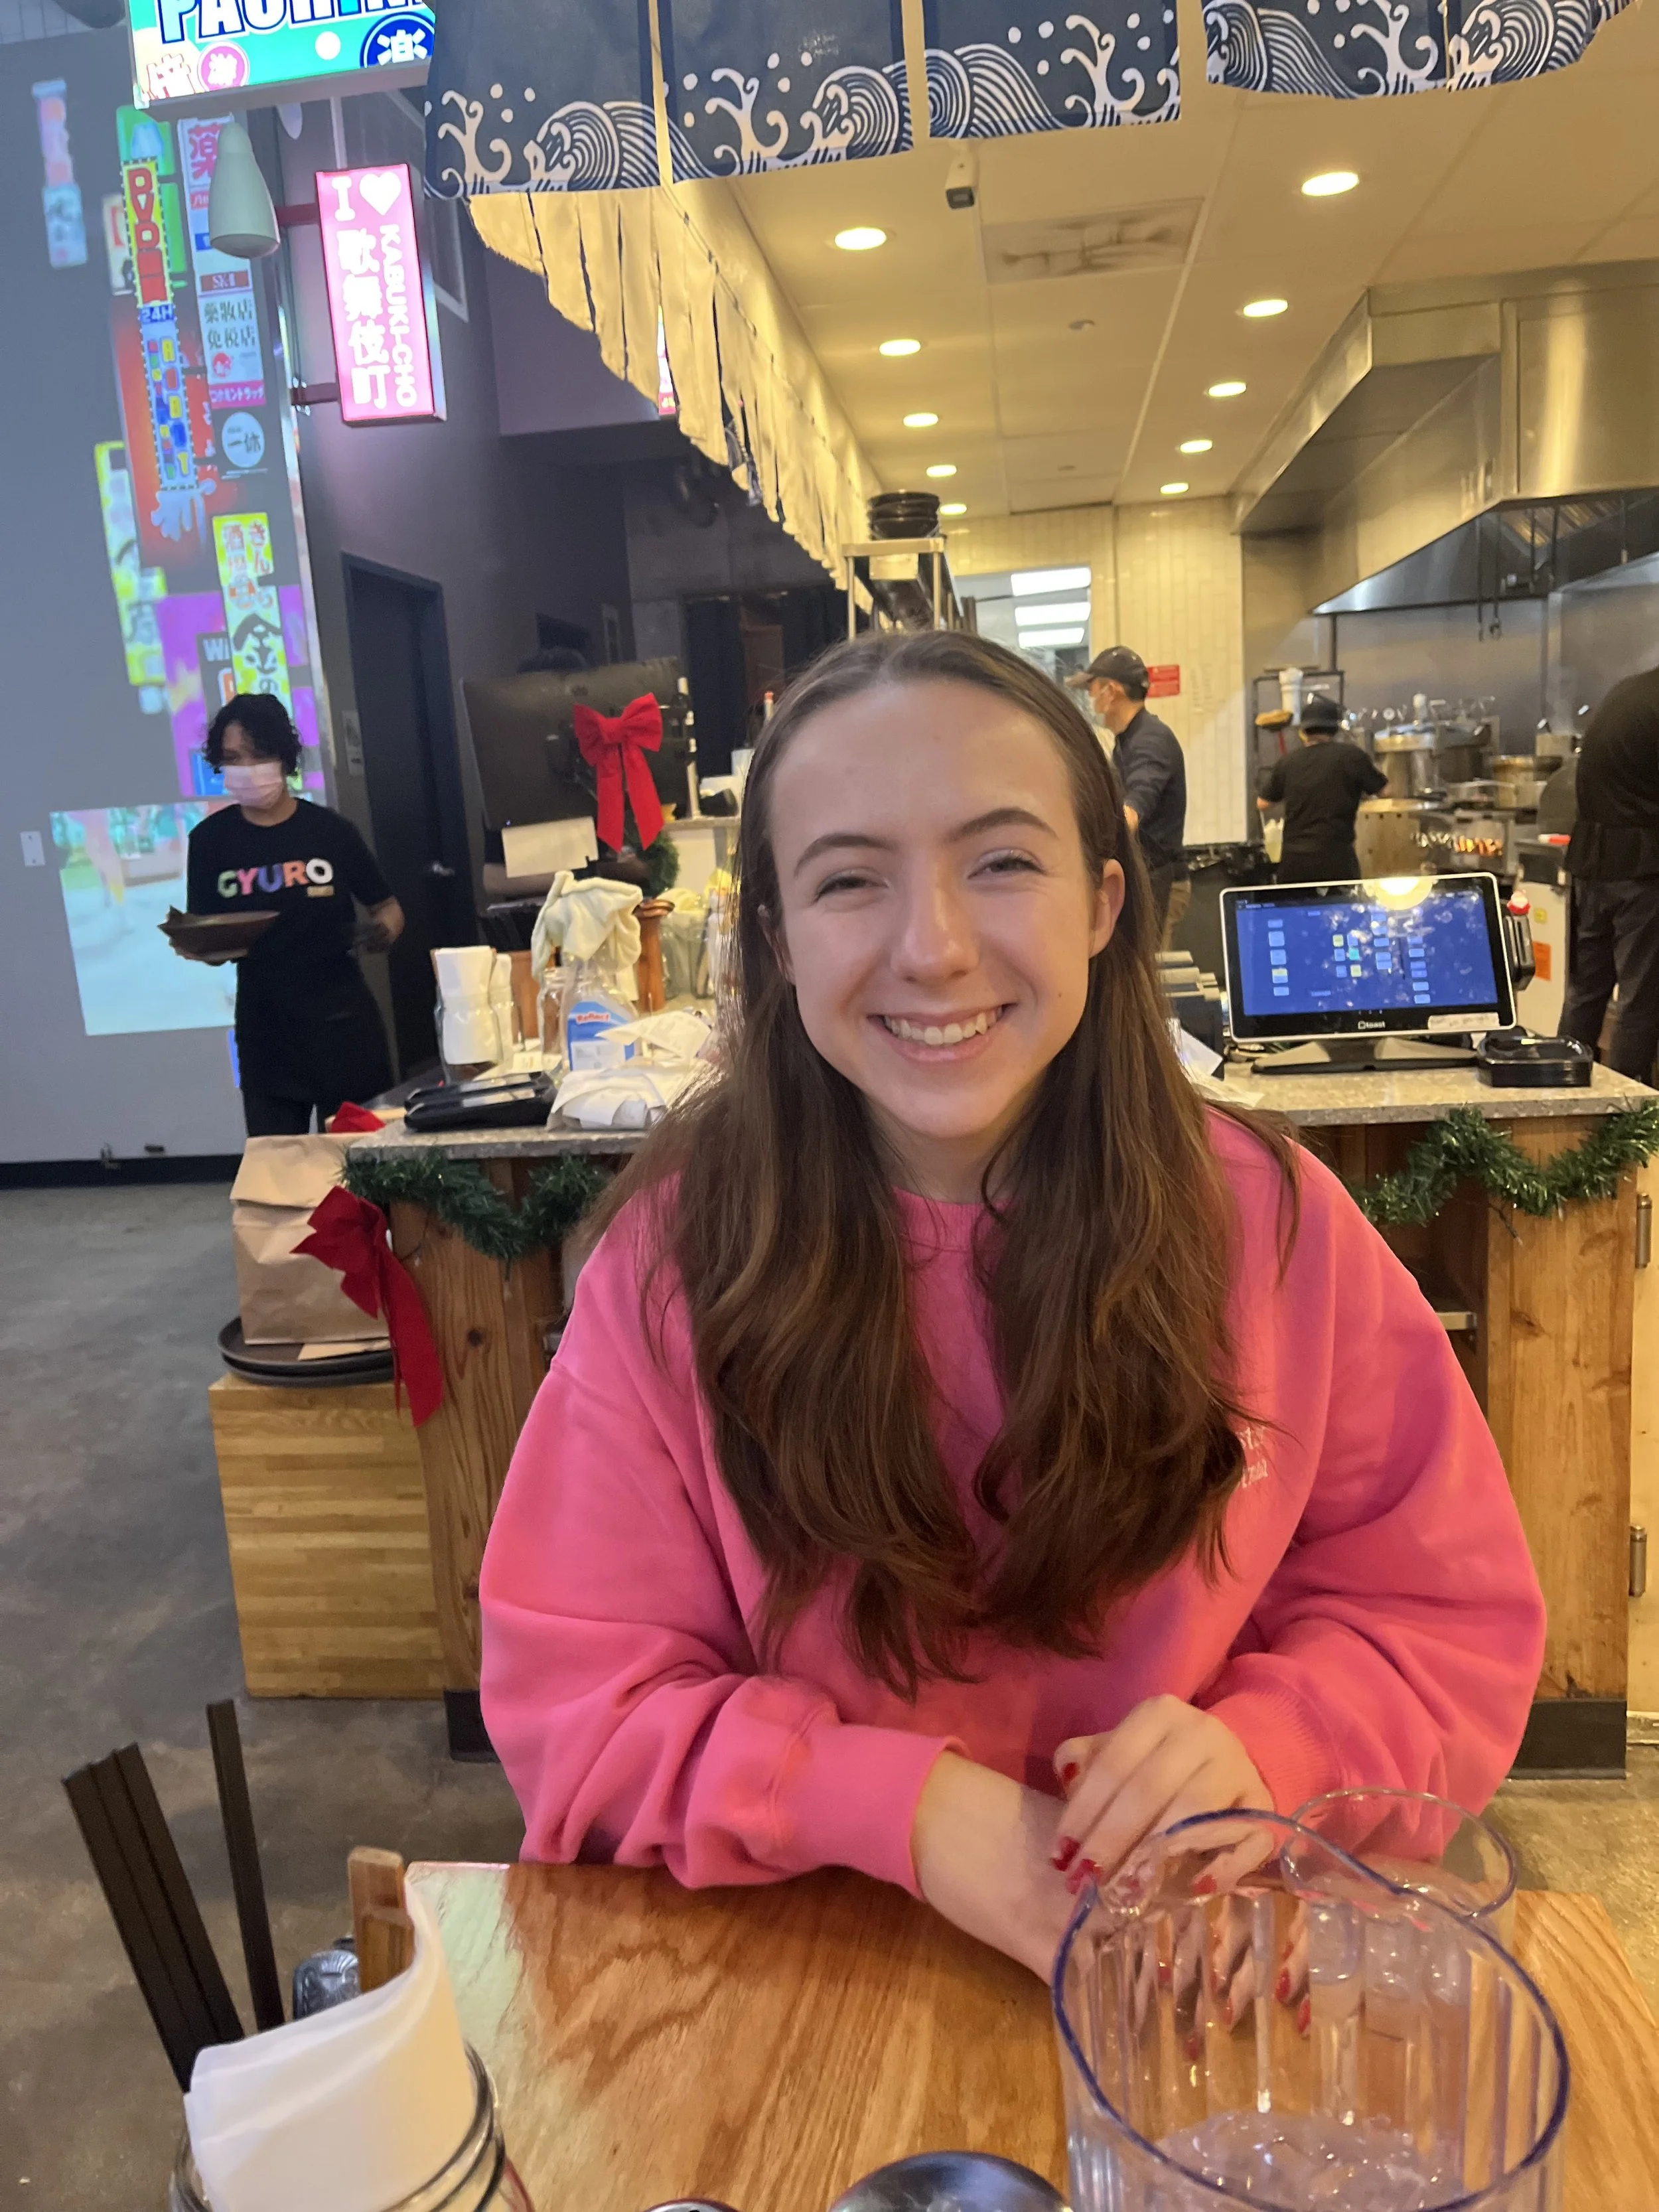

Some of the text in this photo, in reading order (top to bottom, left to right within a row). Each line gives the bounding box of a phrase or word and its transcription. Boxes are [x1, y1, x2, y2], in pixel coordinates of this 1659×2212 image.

[128, 167, 160, 250] DVD
[331, 176, 355, 221] I
[141, 305, 173, 323] 24H
[336, 228, 391, 409] 歌舞伎町
[380, 224, 417, 407] KABUKICHO
[218, 857, 333, 898] GYURO
[1365, 1020, 1386, 1029] toast
